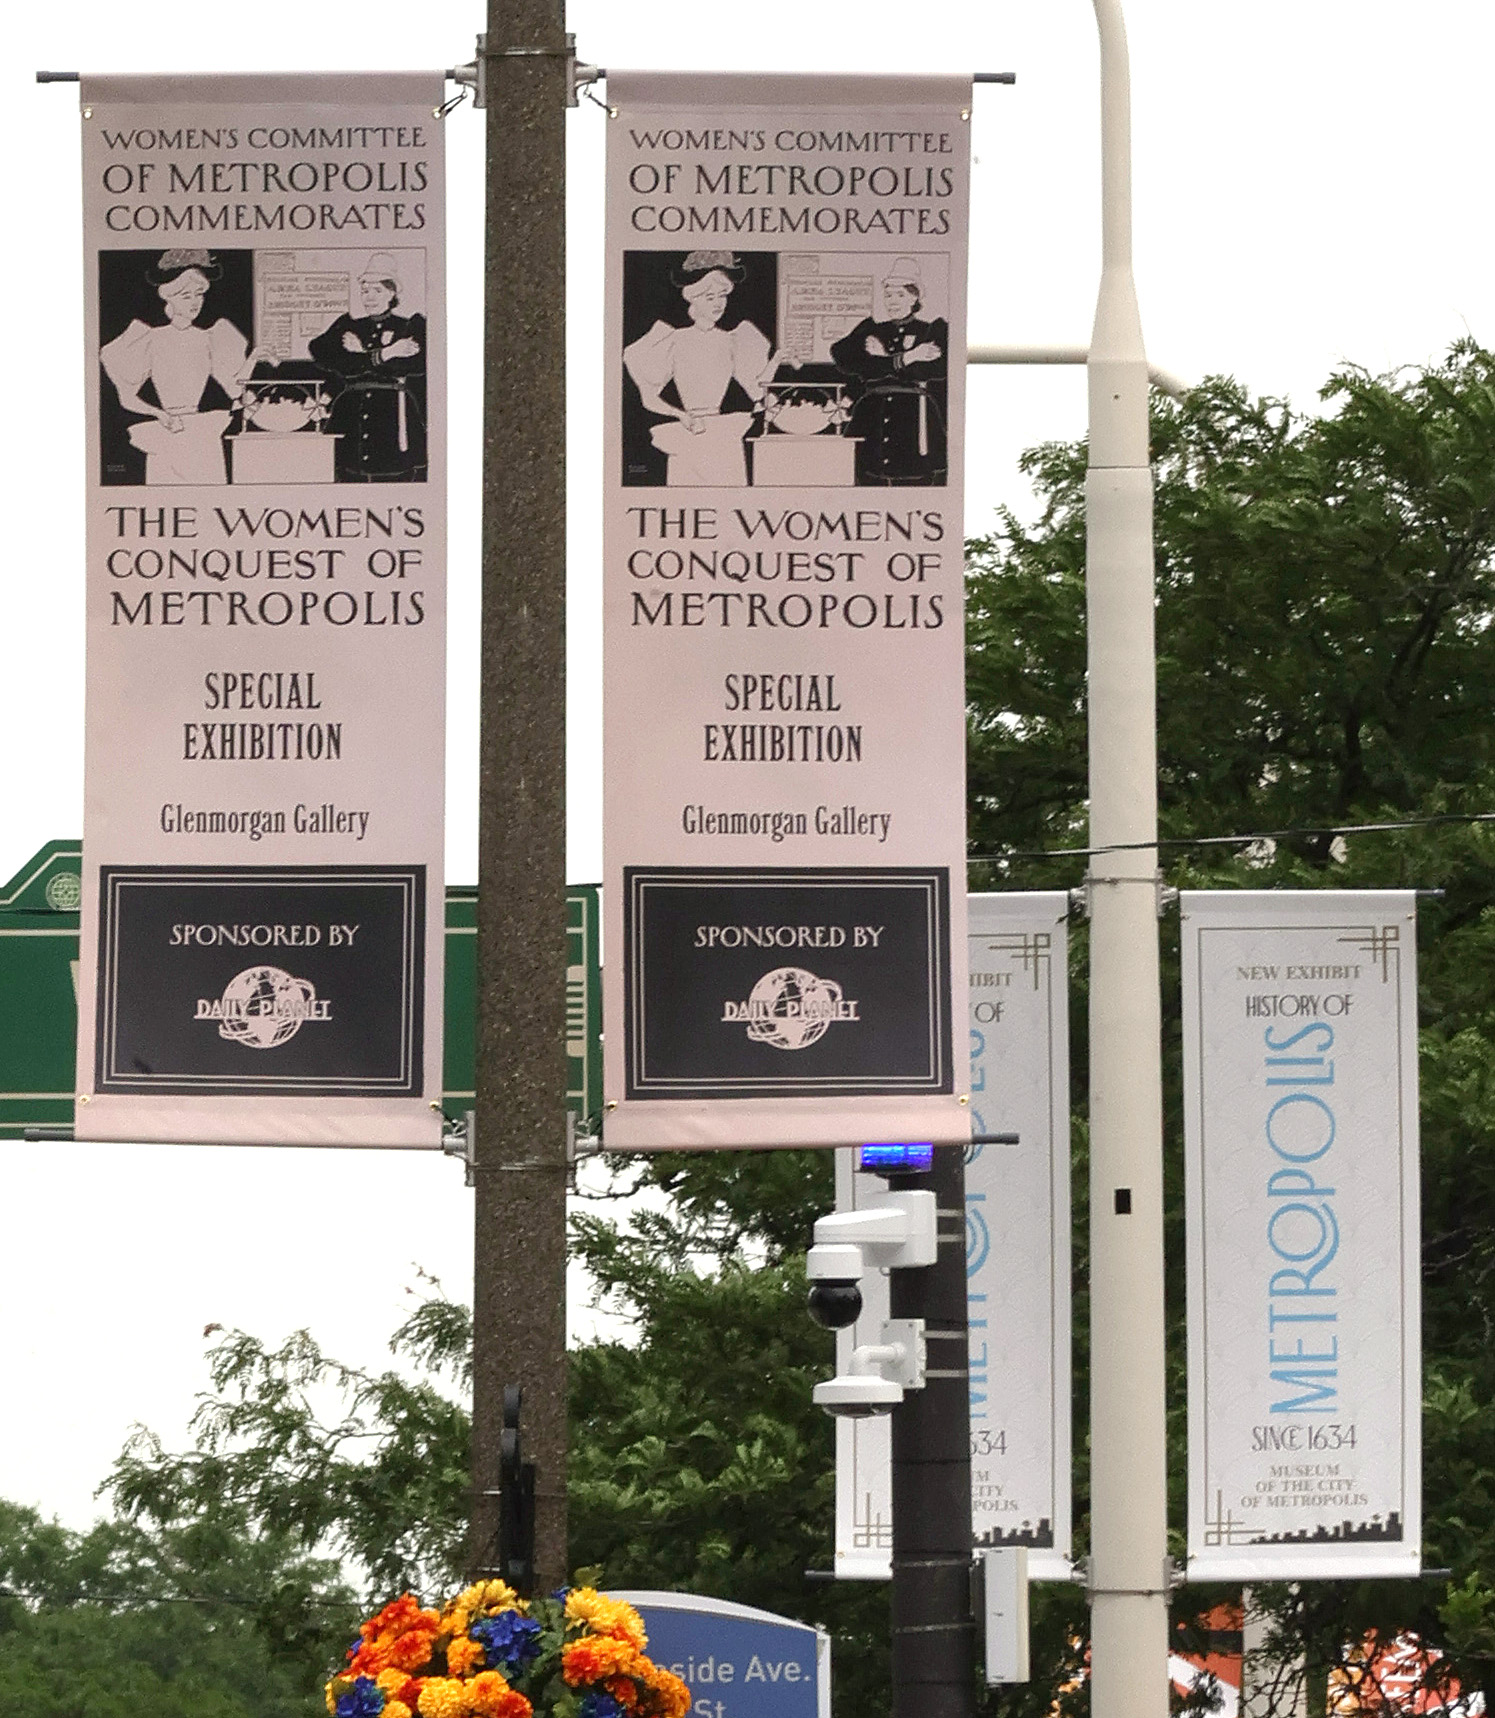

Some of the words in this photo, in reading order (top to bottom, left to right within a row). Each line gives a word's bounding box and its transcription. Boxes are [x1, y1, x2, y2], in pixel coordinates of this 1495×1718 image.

[101, 129, 237, 149] WOMEN'S
[248, 127, 426, 148] COMMITTEE
[630, 130, 765, 151] WOMEN'S
[775, 131, 952, 153] COMMITTEE
[103, 164, 154, 193] OF
[170, 162, 427, 192] METROPOLIS
[630, 165, 681, 193] OF
[696, 165, 952, 197] METROPOLIS
[106, 204, 424, 231] COMMEMORATES
[632, 206, 949, 234] COMMEMORATES
[106, 507, 197, 537] THE
[214, 506, 424, 538] WOMEN'S
[627, 508, 717, 539] THE
[734, 510, 943, 541] WOMEN'S
[107, 549, 344, 581] CONQUEST
[368, 549, 421, 578] OF
[628, 550, 863, 583] CONQUEST
[888, 553, 940, 581] OF
[111, 591, 424, 625] METROPOLIS
[632, 592, 943, 629] METROPOLIS
[205, 672, 321, 709] SPECIAL
[726, 674, 840, 711] SPECIAL
[183, 723, 341, 759] EXHIBITION
[705, 725, 861, 762] EXHIBITION
[161, 804, 285, 841] Glenmorgan
[294, 804, 369, 840] Gallery
[683, 805, 806, 842] Glenmorgan
[815, 806, 890, 842] Gallery
[170, 925, 320, 945] SPONSORED
[330, 925, 359, 945] BY
[695, 927, 845, 947] SPONSORED
[854, 927, 883, 947] BY
[969, 972, 1012, 987] IBIT
[1238, 966, 1280, 980] NEW
[1287, 965, 1360, 979] EXHIBIT
[197, 1000, 249, 1019] DAILY
[259, 1001, 332, 1019] PLANET
[724, 1001, 775, 1020] DAILY
[786, 1001, 859, 1020] PLANET
[974, 1001, 1005, 1023] OF
[1246, 995, 1320, 1016] HISTORY
[1323, 994, 1353, 1015] OF
[1265, 1022, 1339, 1413] METROPOLIS
[1252, 1426, 1302, 1451] SINCE
[1308, 1425, 1356, 1449] 1634
[1271, 1464, 1339, 1477] MUSEUM
[1256, 1481, 1276, 1492] OF
[1283, 1480, 1313, 1491] THE
[1317, 1479, 1354, 1491] CITY
[973, 1500, 1018, 1511] POLIS
[1241, 1496, 1261, 1508] OF
[1268, 1494, 1367, 1507] METROPOLIS
[655, 1655, 734, 1683] side
[744, 1655, 811, 1682] Ave.
